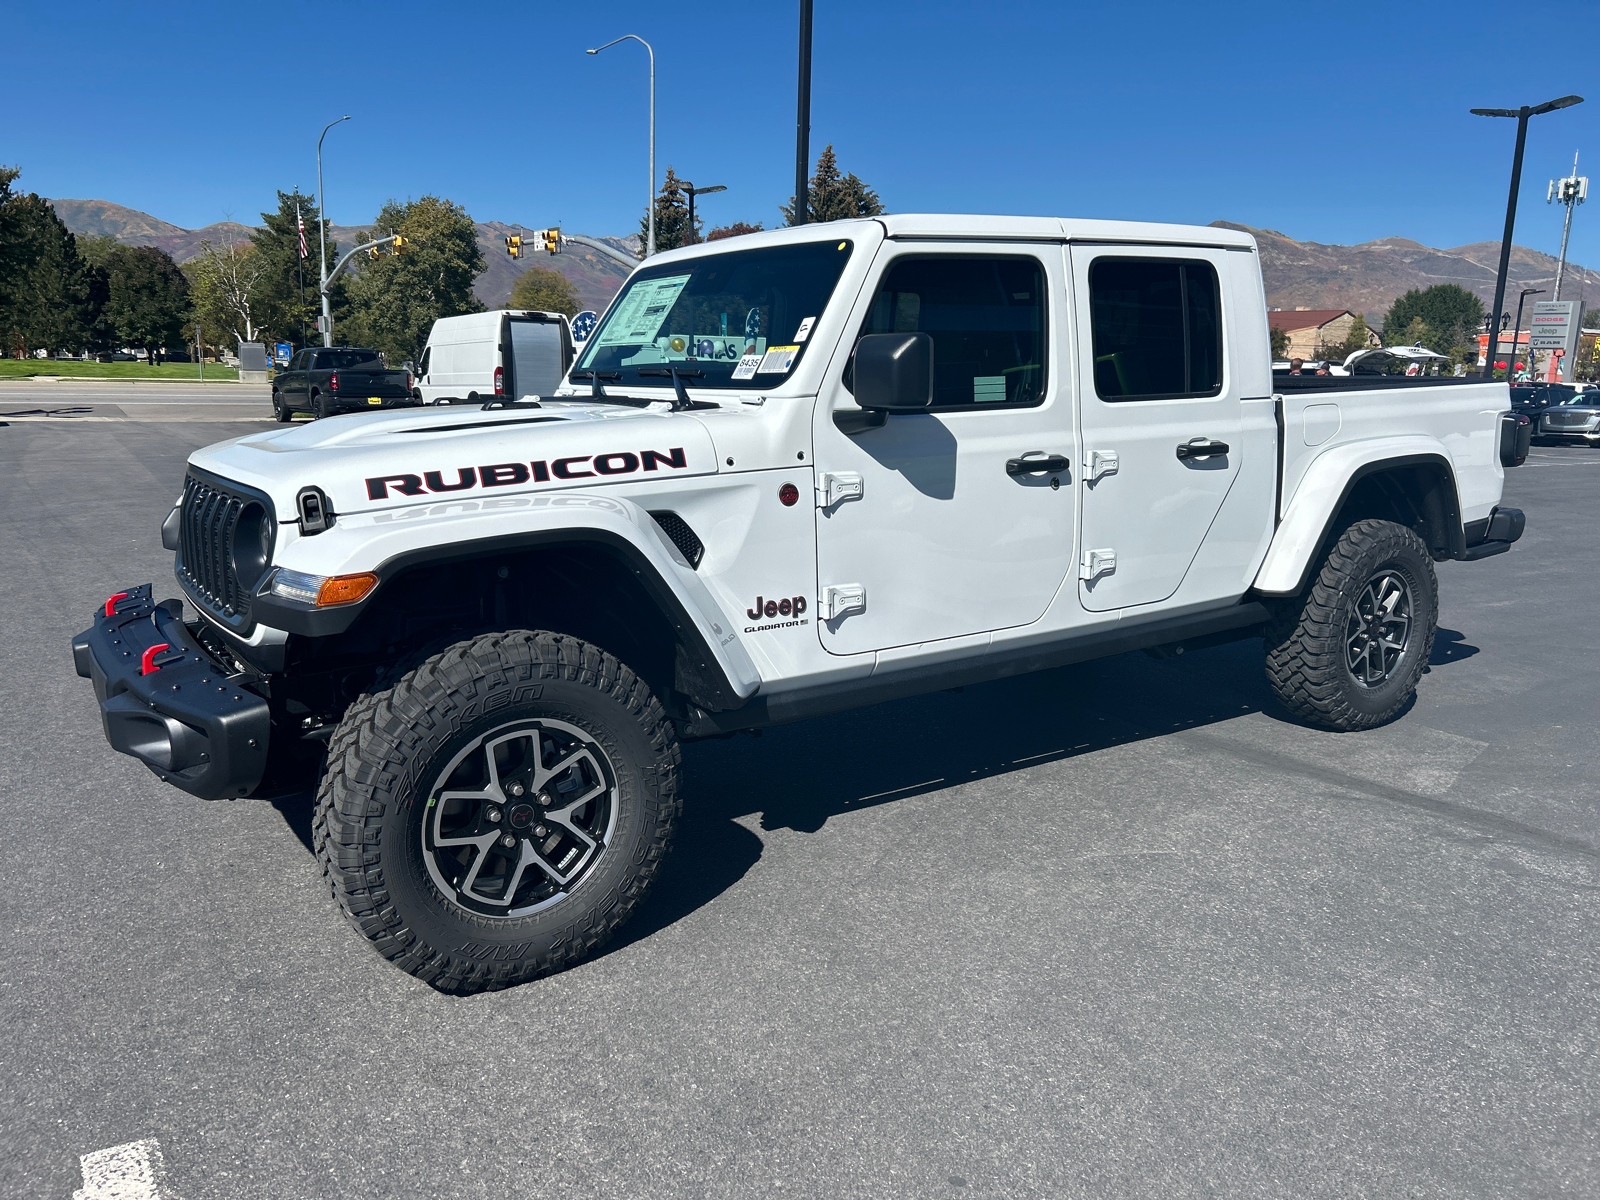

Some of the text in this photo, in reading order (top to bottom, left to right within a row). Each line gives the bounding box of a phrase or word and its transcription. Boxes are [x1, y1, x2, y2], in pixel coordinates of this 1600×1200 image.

[1538, 327, 1558, 335] Jeep
[740, 358, 760, 367] 8435
[365, 447, 687, 500] RUBICON
[747, 595, 807, 620] Jeep
[744, 620, 799, 633] GLADIATOR
